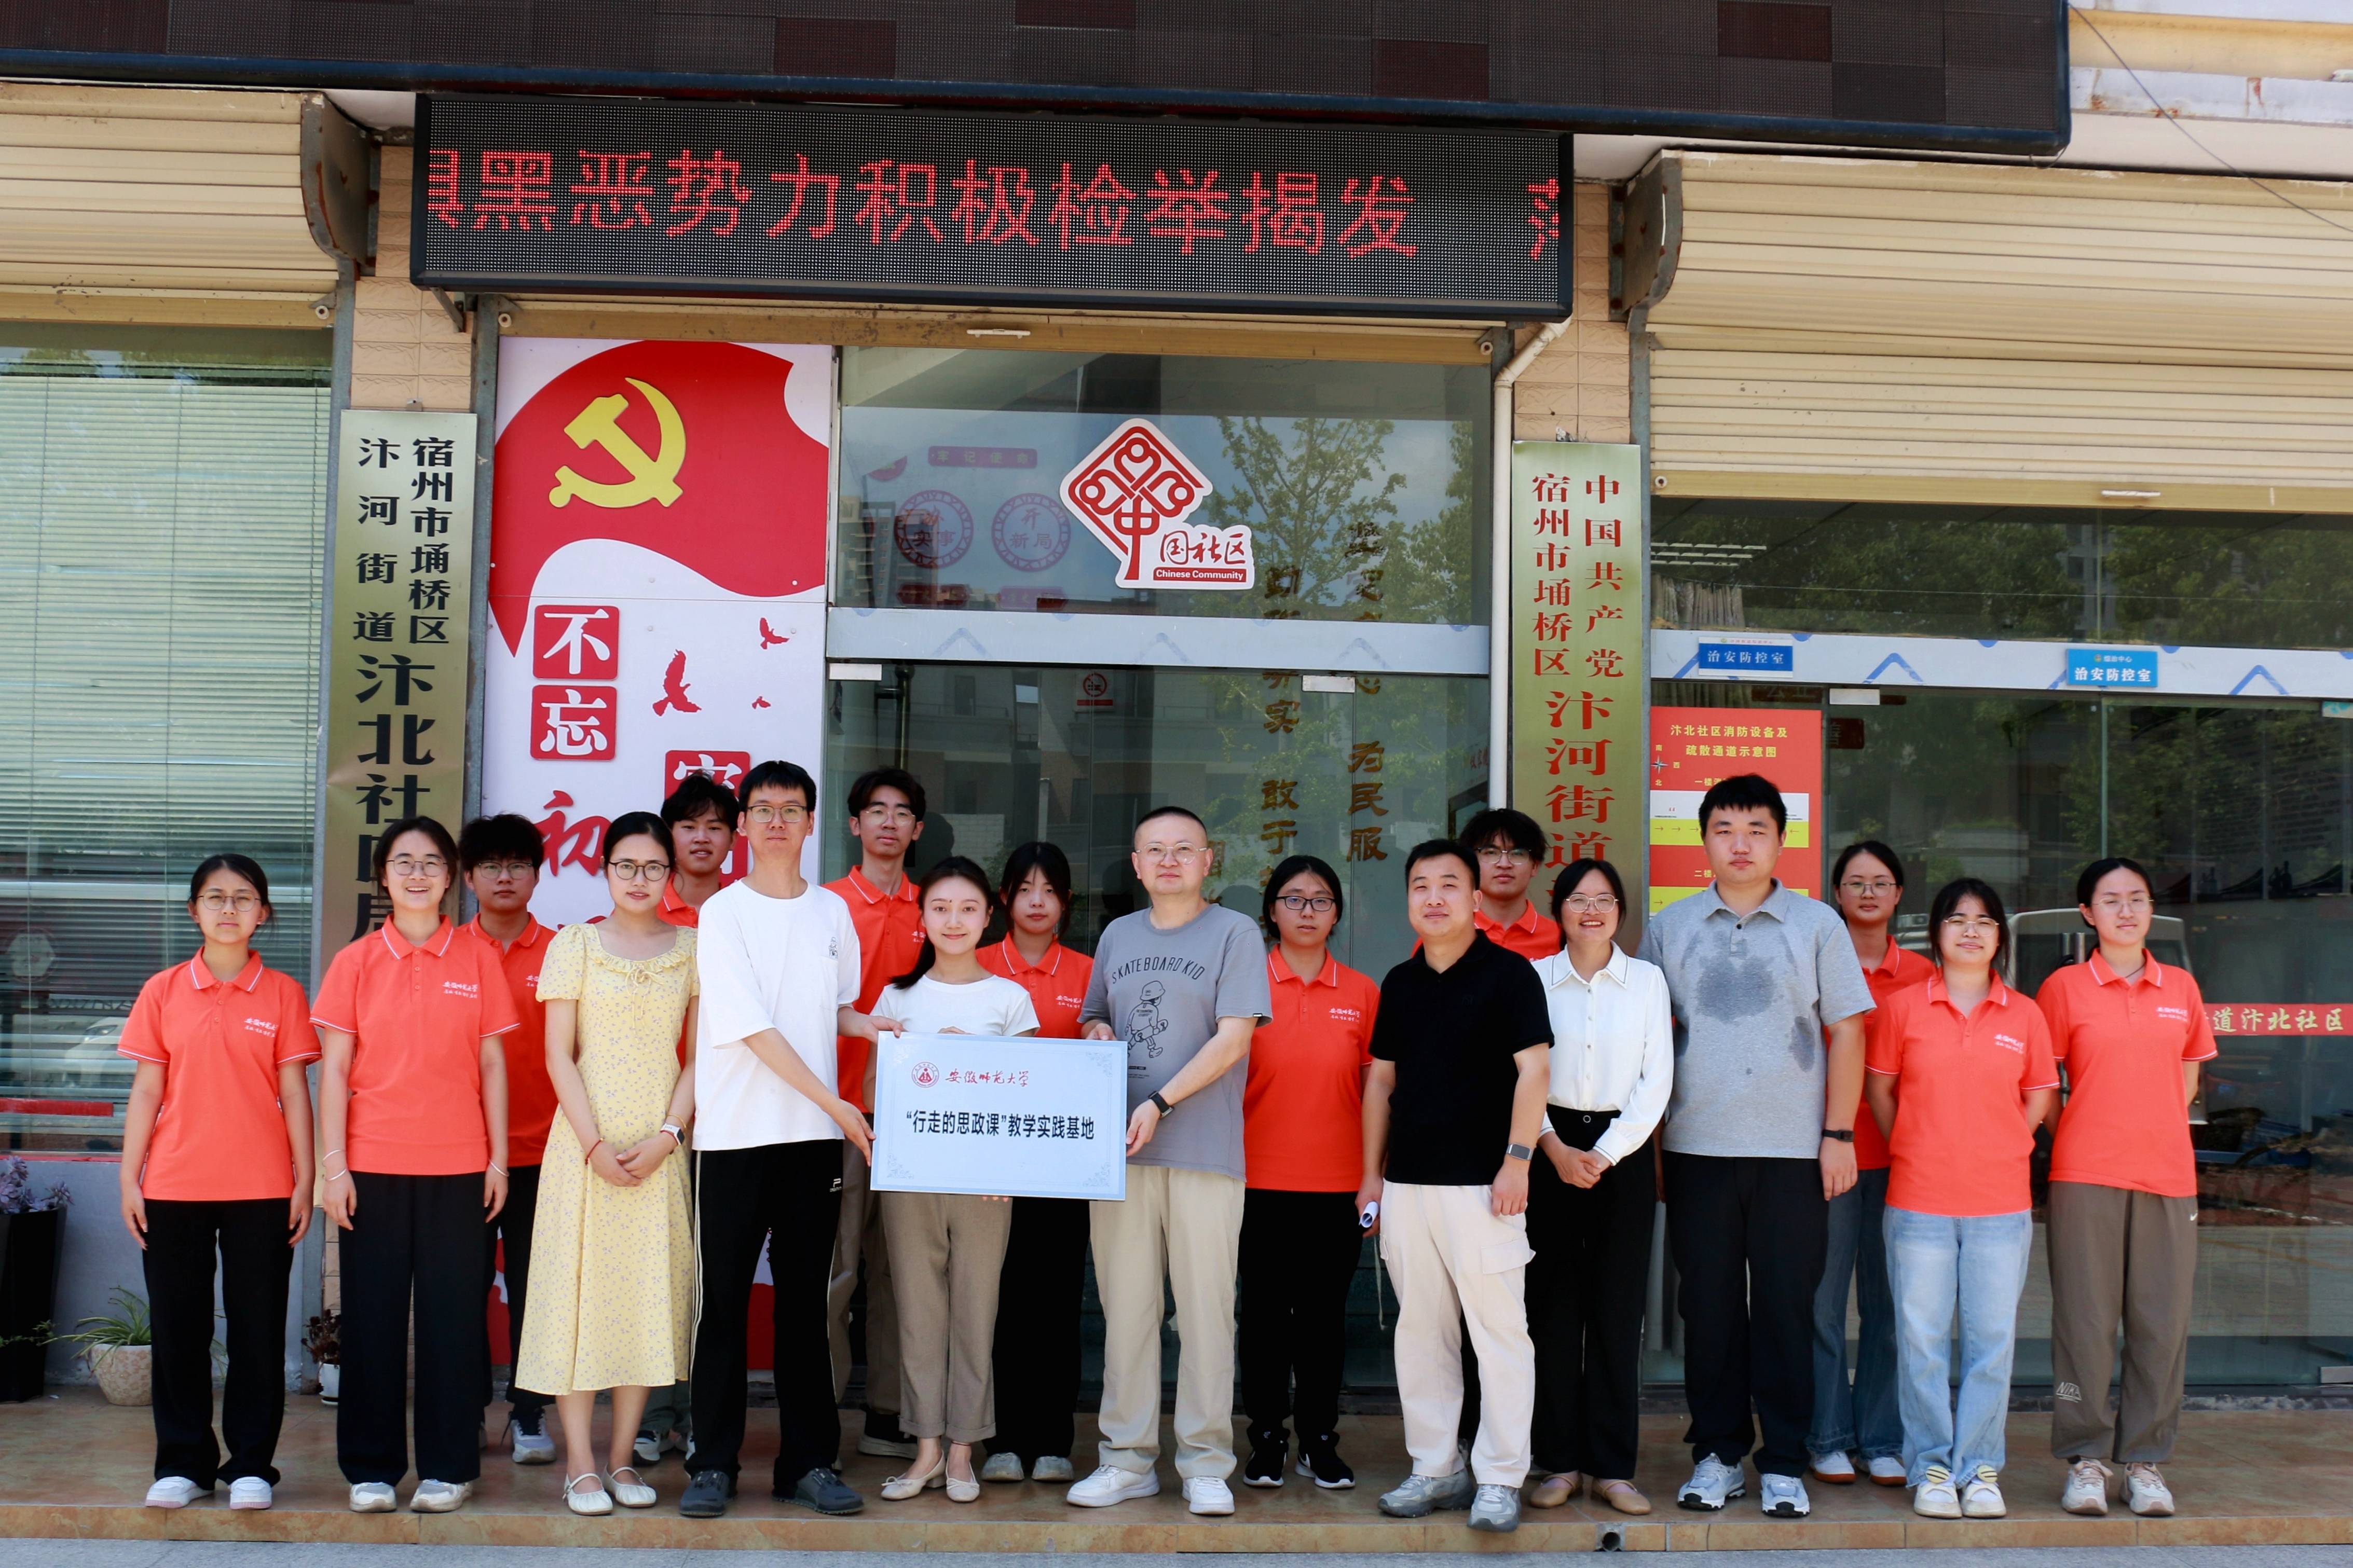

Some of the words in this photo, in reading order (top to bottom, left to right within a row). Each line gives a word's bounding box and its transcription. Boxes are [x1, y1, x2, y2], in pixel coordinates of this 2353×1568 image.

[353, 437, 401, 642] 汴河街道
[408, 436, 455, 644] 宿州市埇桥区
[1156, 569, 1191, 578] Chinese
[1192, 570, 1243, 580] Community
[1531, 473, 1572, 676] 宿州市埇桥区
[1585, 474, 1624, 678] 中国共产党
[1707, 650, 1784, 664] 治安防控室
[2074, 667, 2151, 682] 治安防控室
[1670, 724, 1788, 738] 汴北社区消防设备及
[1686, 745, 1777, 758] 疏散通道示意图
[535, 608, 612, 932] 不忘初
[350, 654, 436, 942] 汴北社
[1544, 691, 1615, 904] 汴河街道
[1694, 870, 1716, 878] 二楼
[1112, 956, 1183, 984] SKATEBOARD
[1182, 959, 1205, 980] KID
[2204, 1006, 2344, 1033] 道汴北社区
[945, 1068, 1030, 1087] 安徽师范大学
[906, 1109, 1095, 1140] “行走的思政课”教学实践基地
